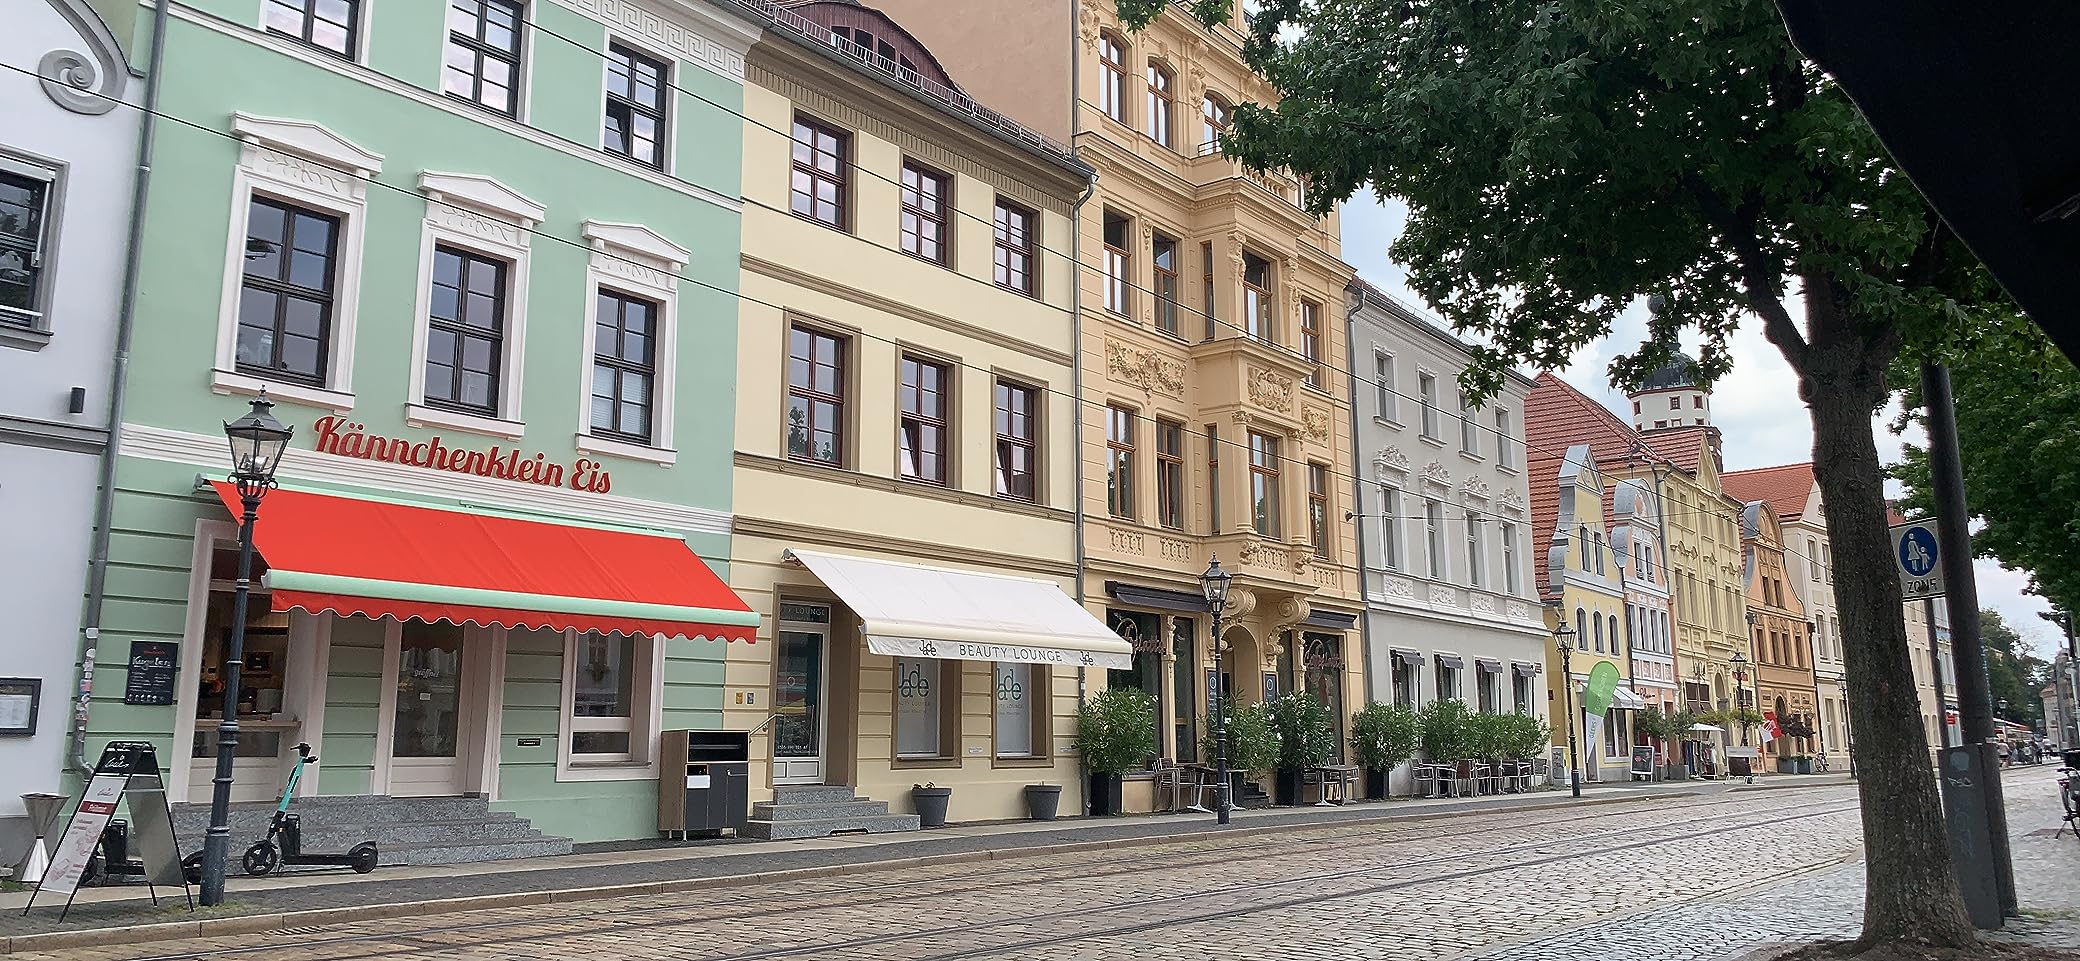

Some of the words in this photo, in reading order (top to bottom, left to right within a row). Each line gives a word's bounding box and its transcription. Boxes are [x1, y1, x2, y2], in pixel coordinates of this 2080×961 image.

[313, 416, 563, 487] Kännchenklein
[570, 458, 611, 494] Eis
[795, 607, 825, 616] LOUNGE
[959, 645, 1009, 659] BEAUTY
[1012, 648, 1063, 662] LOUNGE
